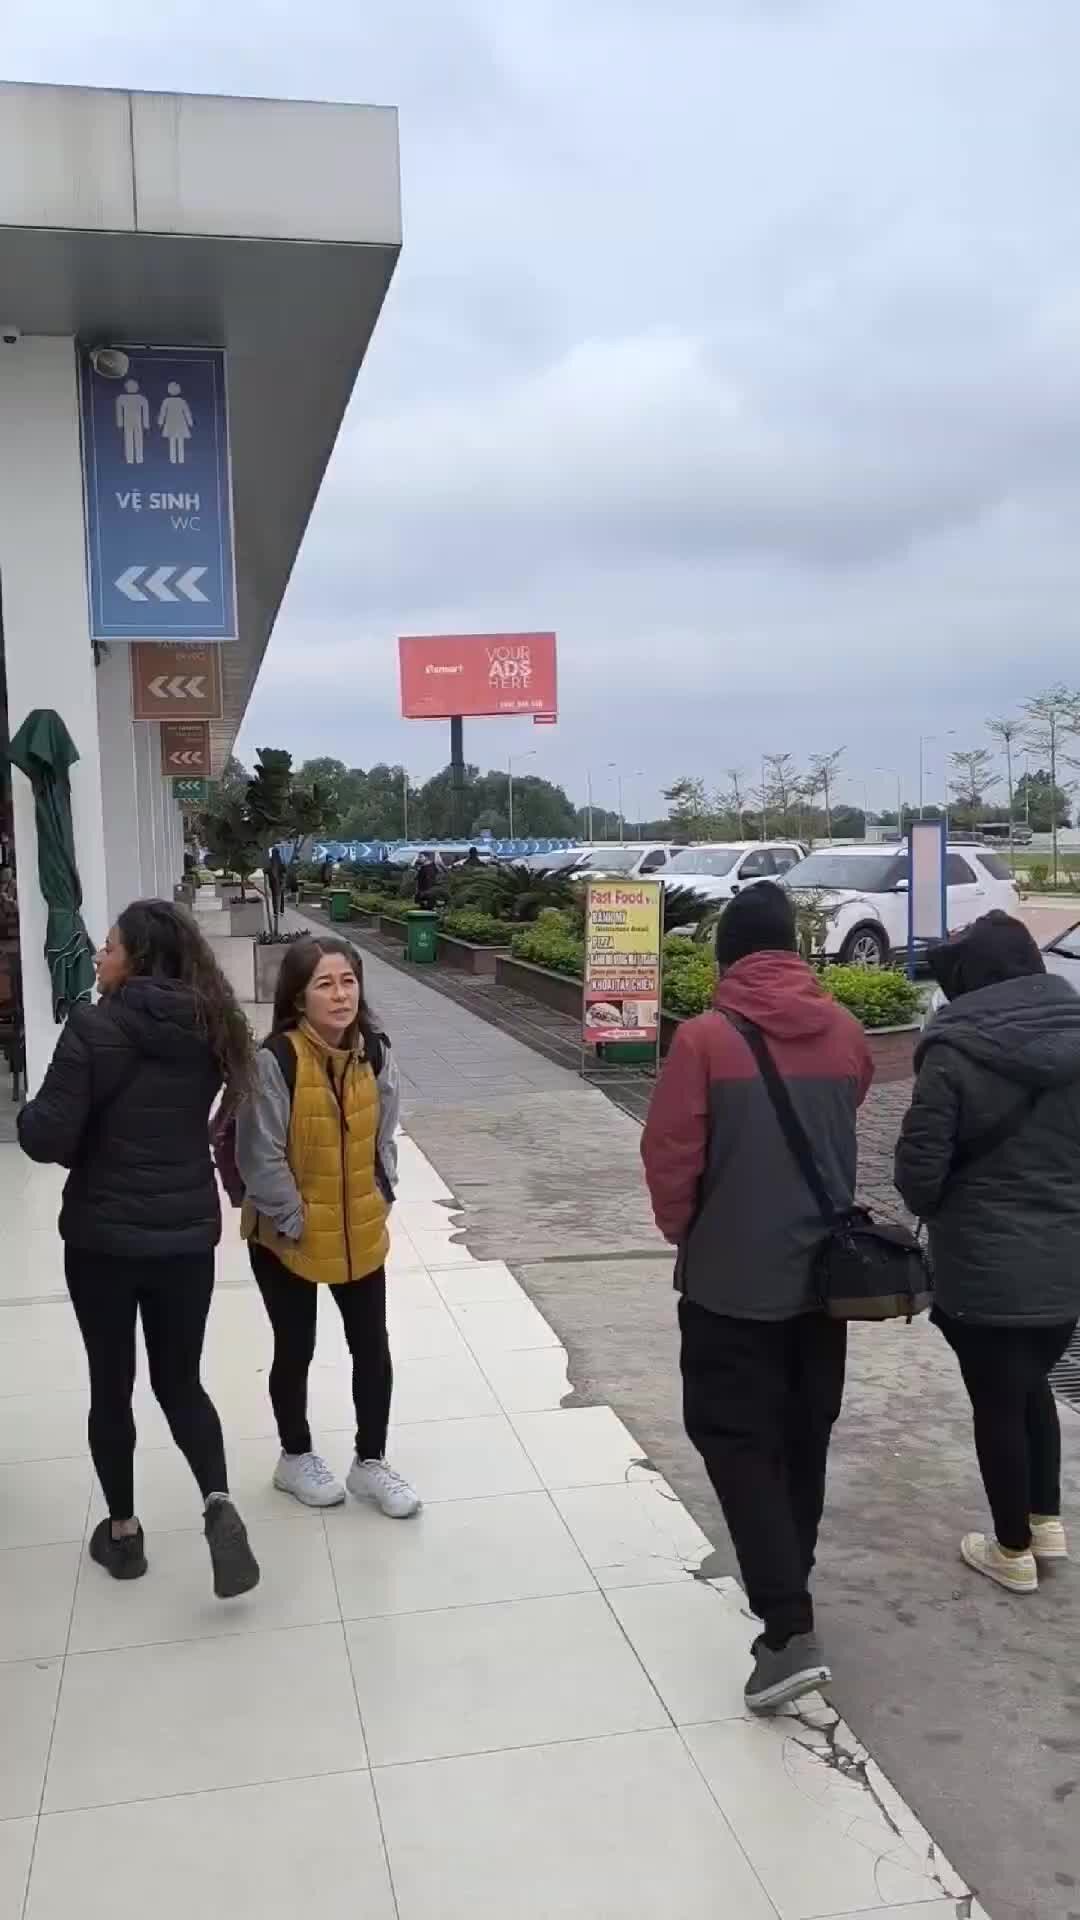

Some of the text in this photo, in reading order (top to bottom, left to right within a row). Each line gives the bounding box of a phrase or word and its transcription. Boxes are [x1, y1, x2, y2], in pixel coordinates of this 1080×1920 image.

[115, 488, 200, 512] VỆ SINH
[170, 515, 200, 531] WC
[485, 646, 531, 662] YOUR
[489, 660, 532, 677] ADS
[488, 675, 533, 689] HERE
[591, 890, 611, 904] Fast
[616, 889, 643, 904] Food
